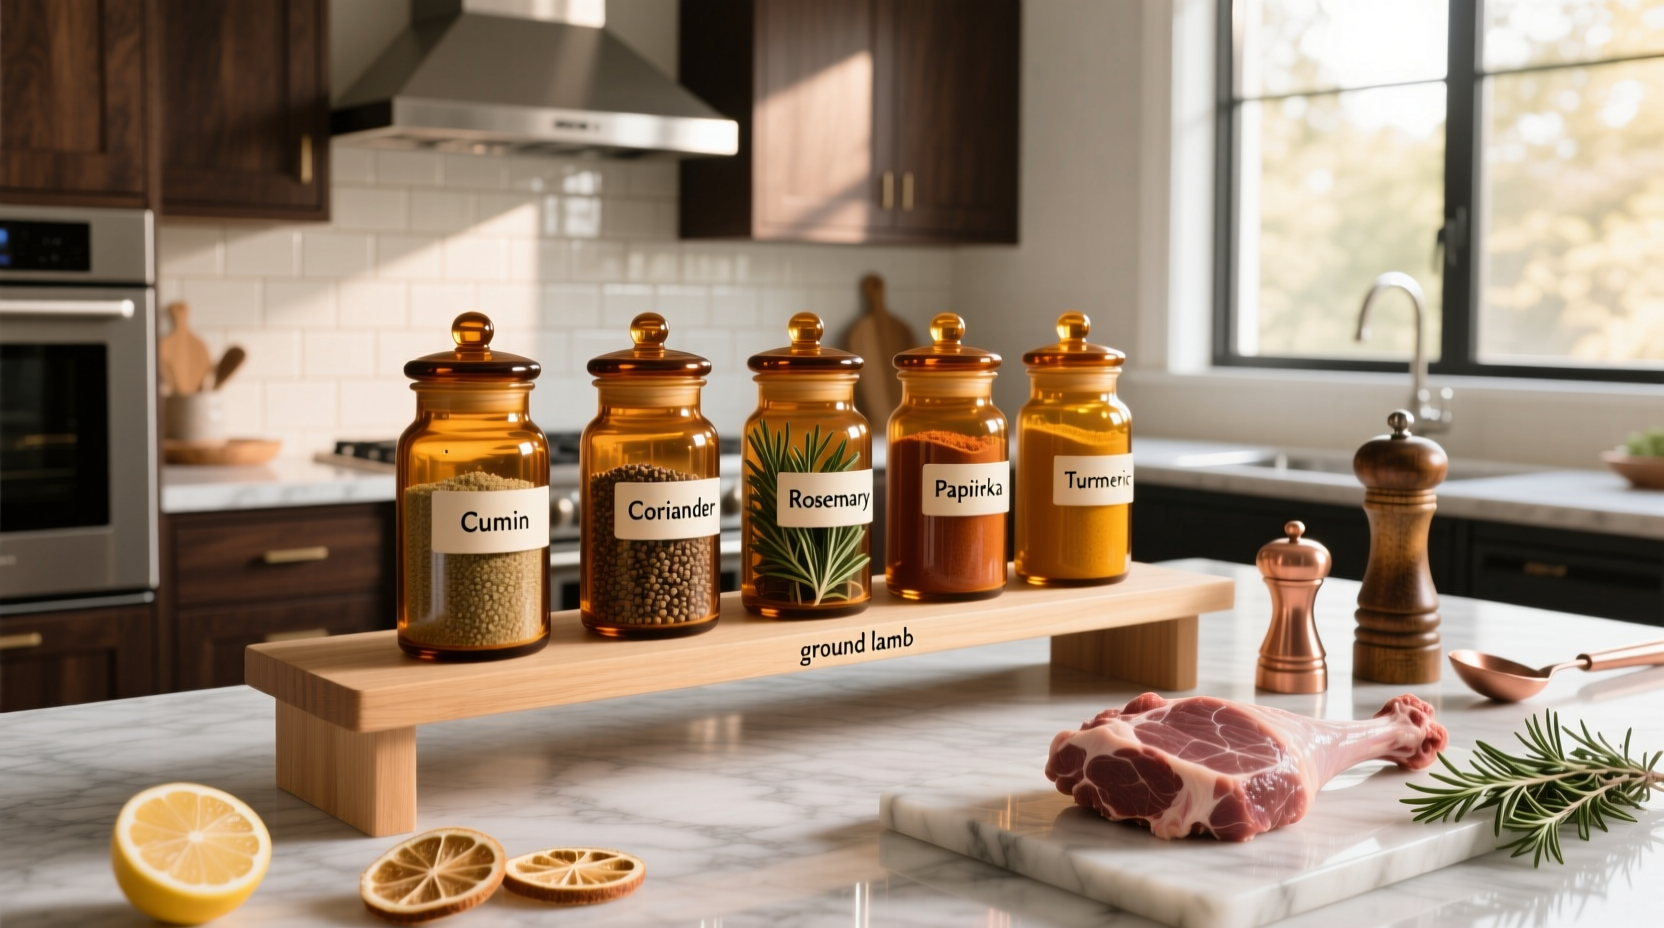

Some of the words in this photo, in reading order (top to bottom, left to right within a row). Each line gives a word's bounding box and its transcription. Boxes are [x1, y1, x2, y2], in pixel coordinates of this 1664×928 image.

[1065, 470, 1131, 489] Turmeric
[628, 497, 716, 521] Coriander
[789, 489, 870, 512] Rosemary
[461, 511, 529, 533] Cumin
[800, 632, 866, 666] ground
[871, 626, 914, 651] lamb
